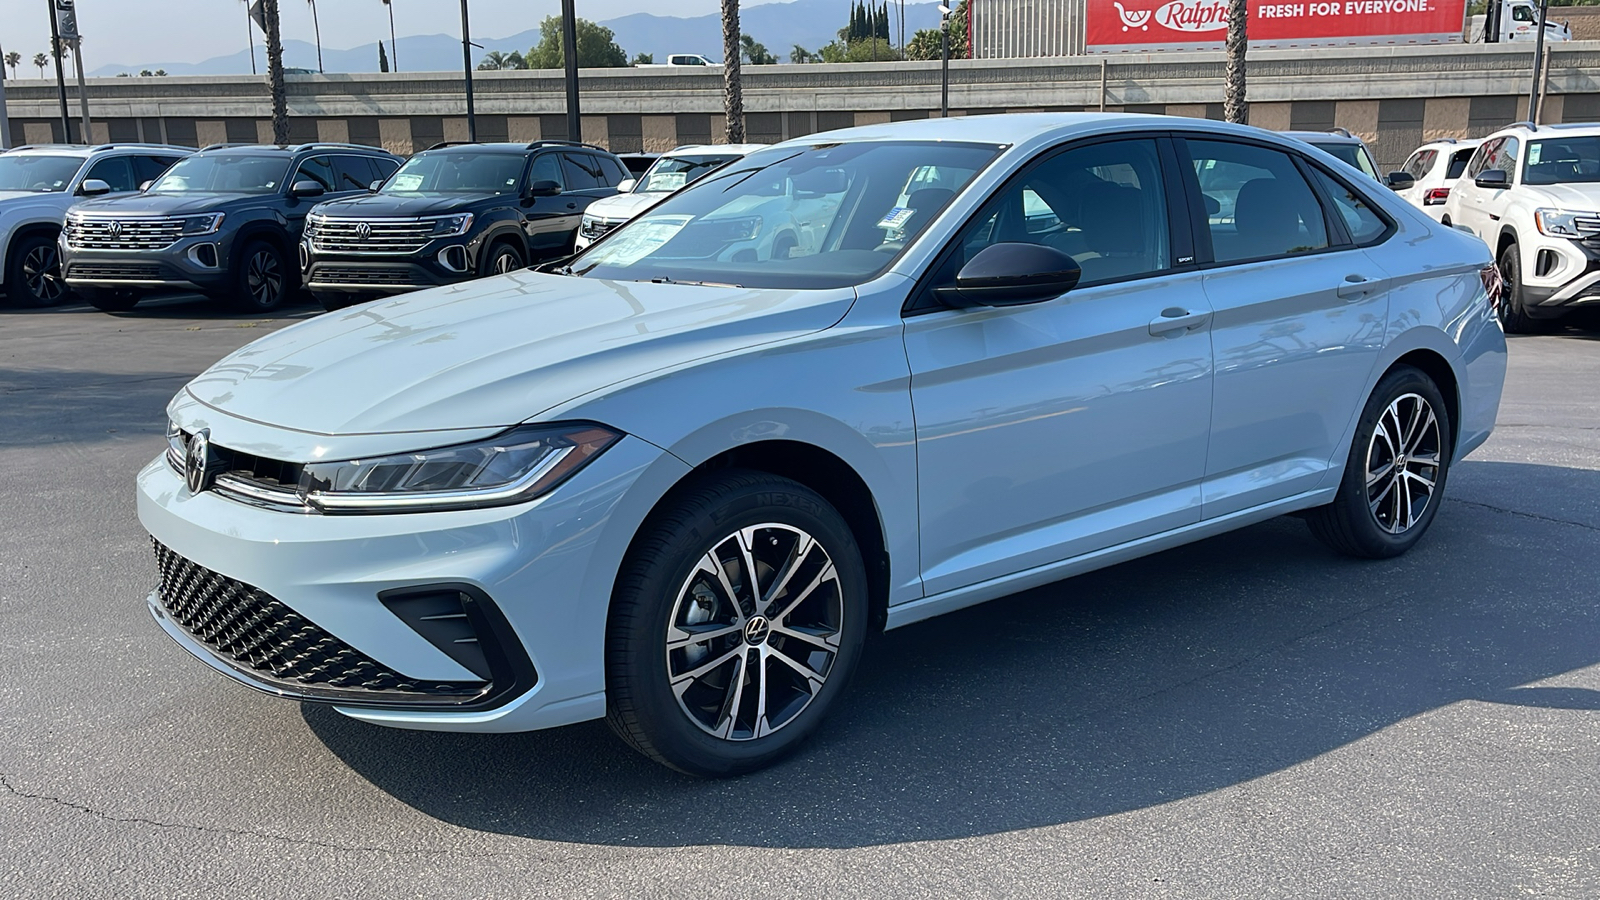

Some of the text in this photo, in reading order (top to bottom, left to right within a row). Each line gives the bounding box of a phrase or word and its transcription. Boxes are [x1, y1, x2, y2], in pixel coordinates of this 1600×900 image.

[1258, 4, 1304, 19] FRESH
[1308, 2, 1341, 17] FOR
[756, 492, 823, 517] NEXEN
